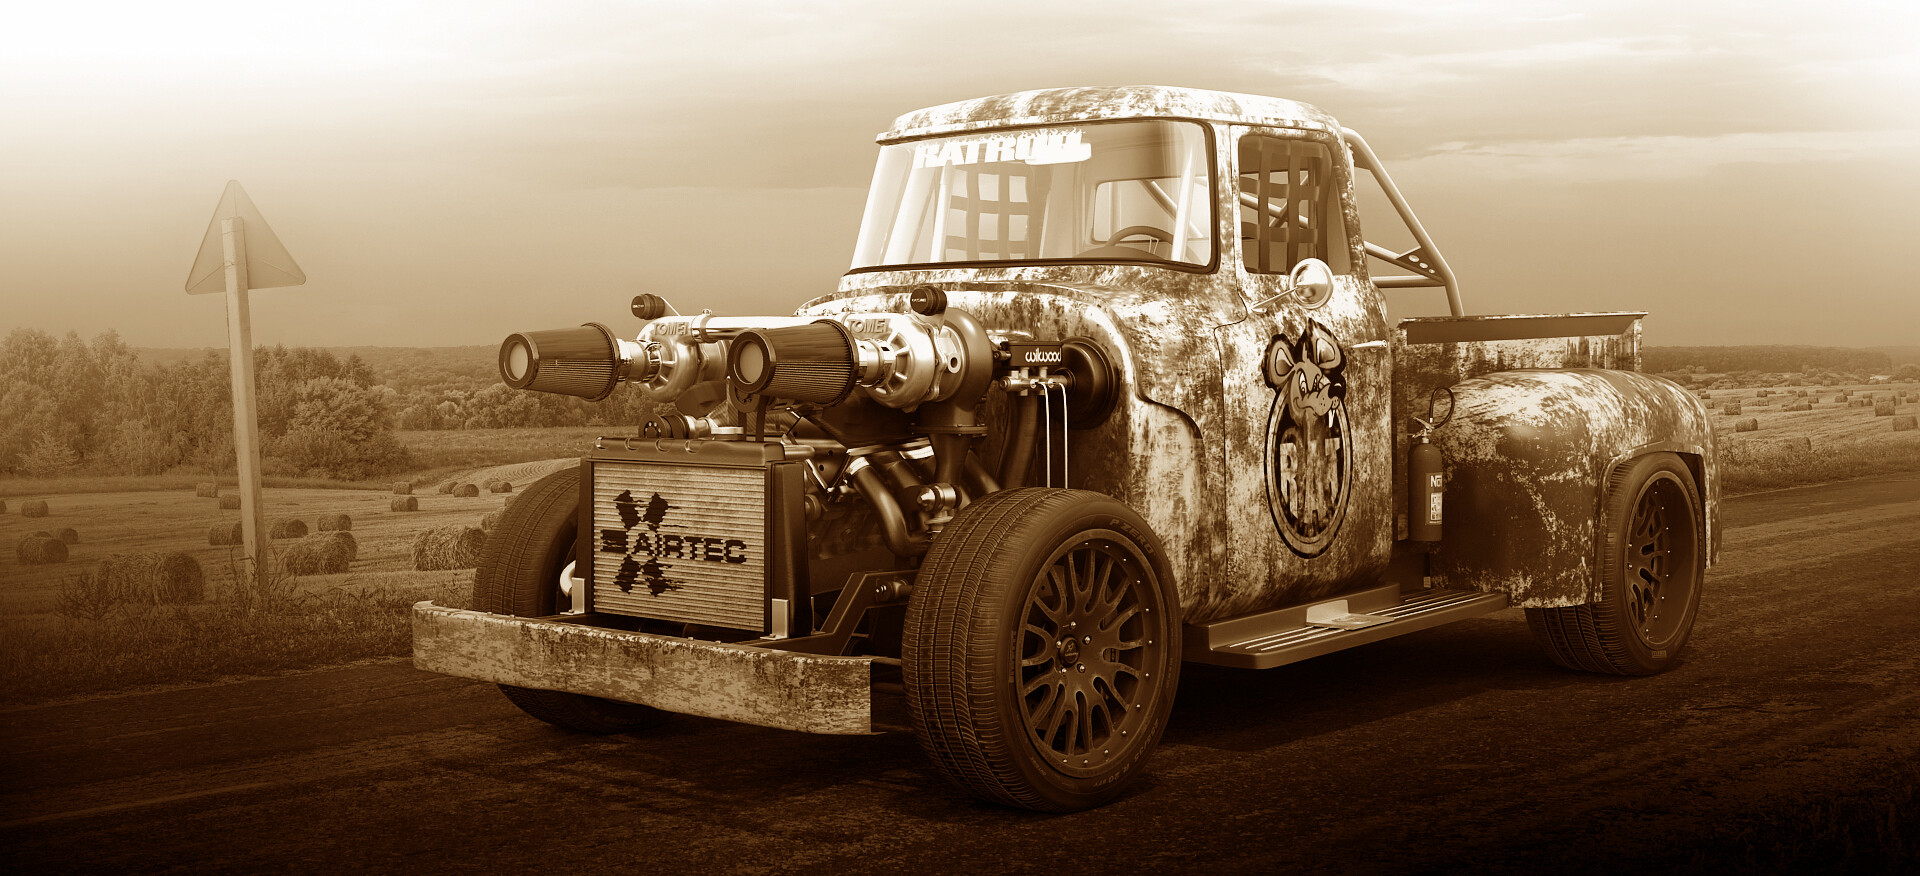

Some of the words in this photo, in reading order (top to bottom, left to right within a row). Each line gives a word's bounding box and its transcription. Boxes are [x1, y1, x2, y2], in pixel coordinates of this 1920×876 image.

[652, 321, 690, 336] TOMEI
[847, 318, 891, 333] TOMEI
[631, 532, 747, 564] AIRTEC
